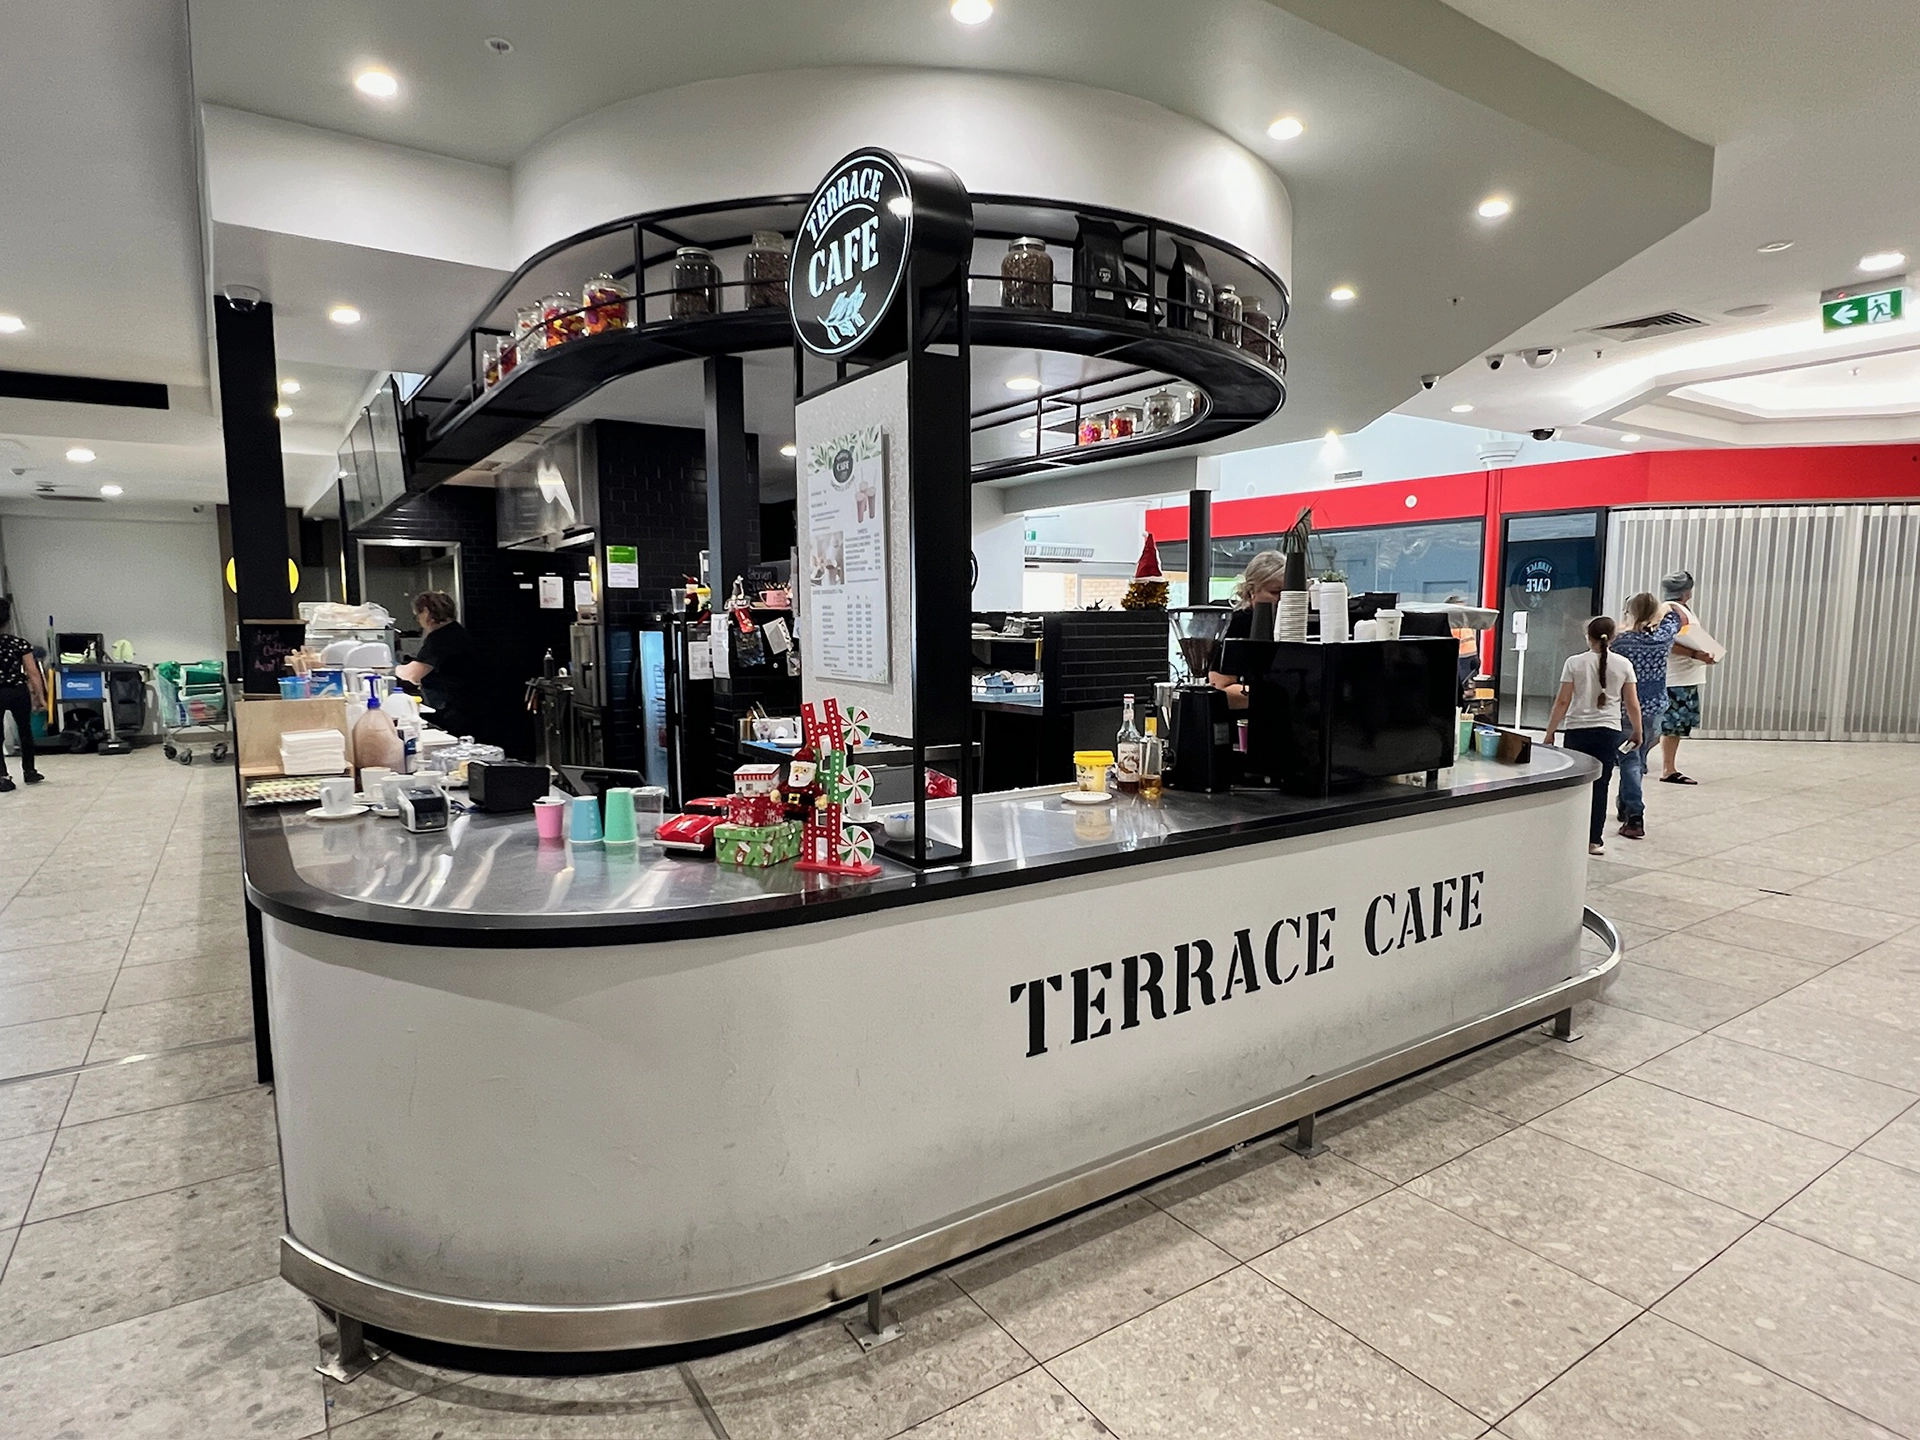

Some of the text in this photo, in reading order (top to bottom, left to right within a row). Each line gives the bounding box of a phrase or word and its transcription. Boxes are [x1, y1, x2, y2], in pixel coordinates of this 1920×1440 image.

[806, 167, 884, 242] TERRACE
[808, 215, 879, 299] CAFE
[1009, 871, 1485, 1058] TERRACE CAFE
